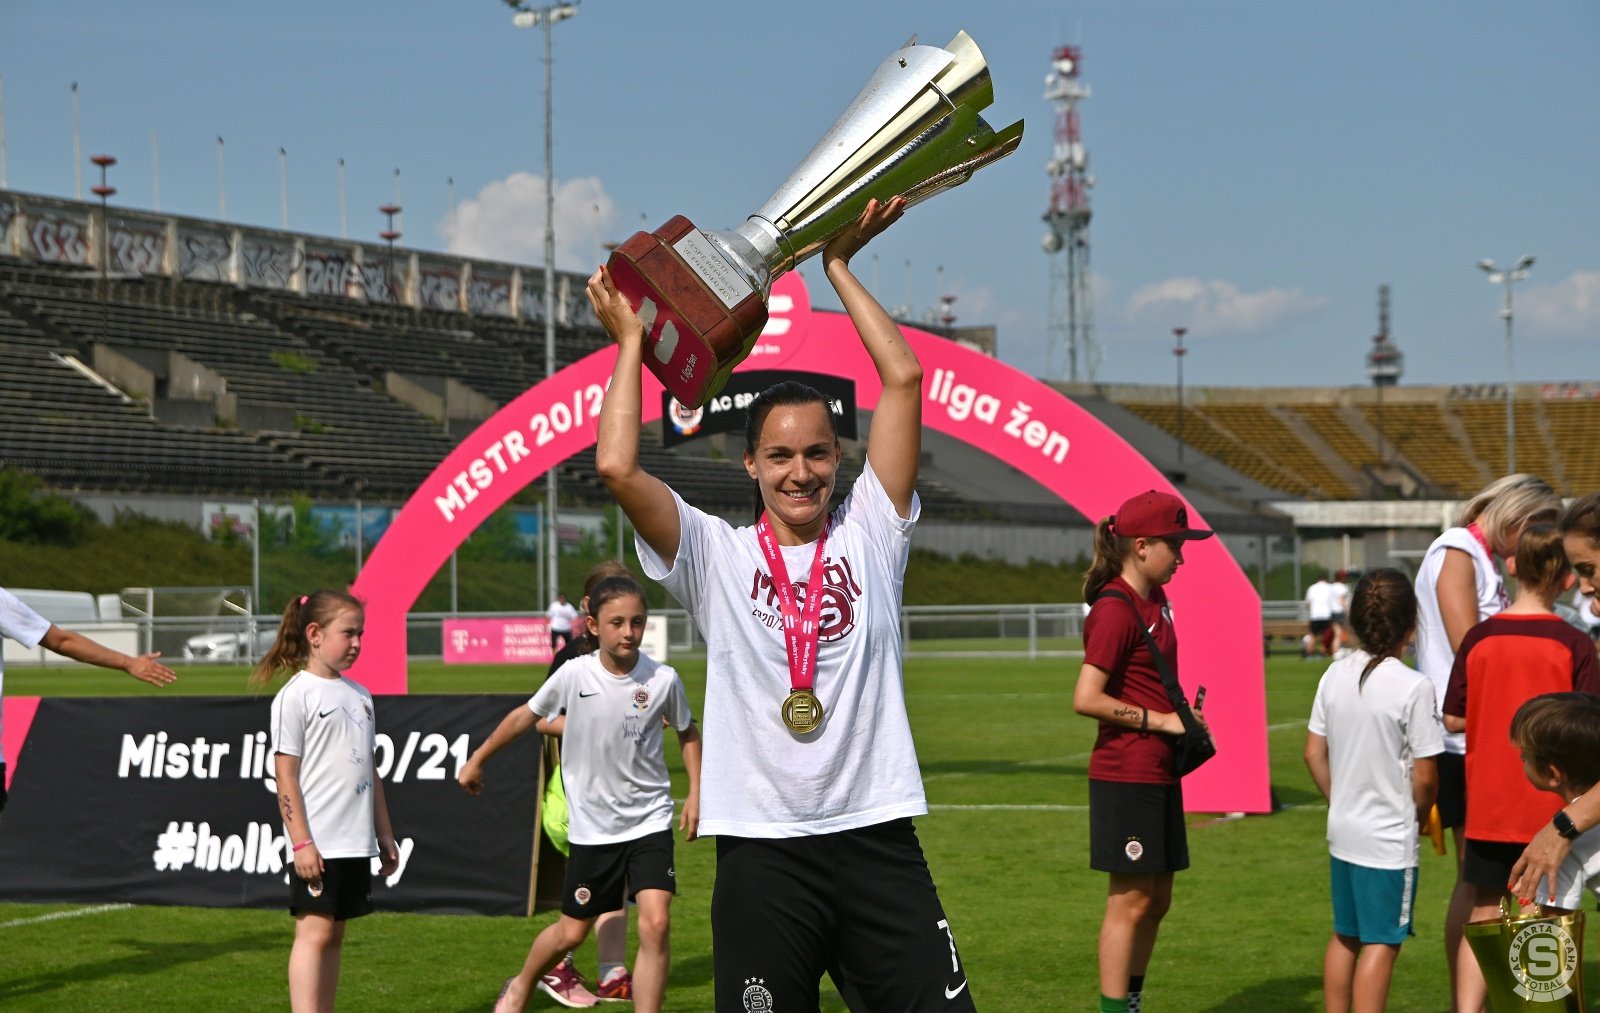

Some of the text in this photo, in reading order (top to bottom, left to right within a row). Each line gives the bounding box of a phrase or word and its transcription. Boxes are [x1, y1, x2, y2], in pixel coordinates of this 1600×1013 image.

[710, 395, 732, 414] AC
[928, 367, 1070, 464] liga žen
[435, 376, 612, 523] MISTR 20/2
[118, 731, 230, 779] Mistr
[374, 732, 470, 783] 0/21
